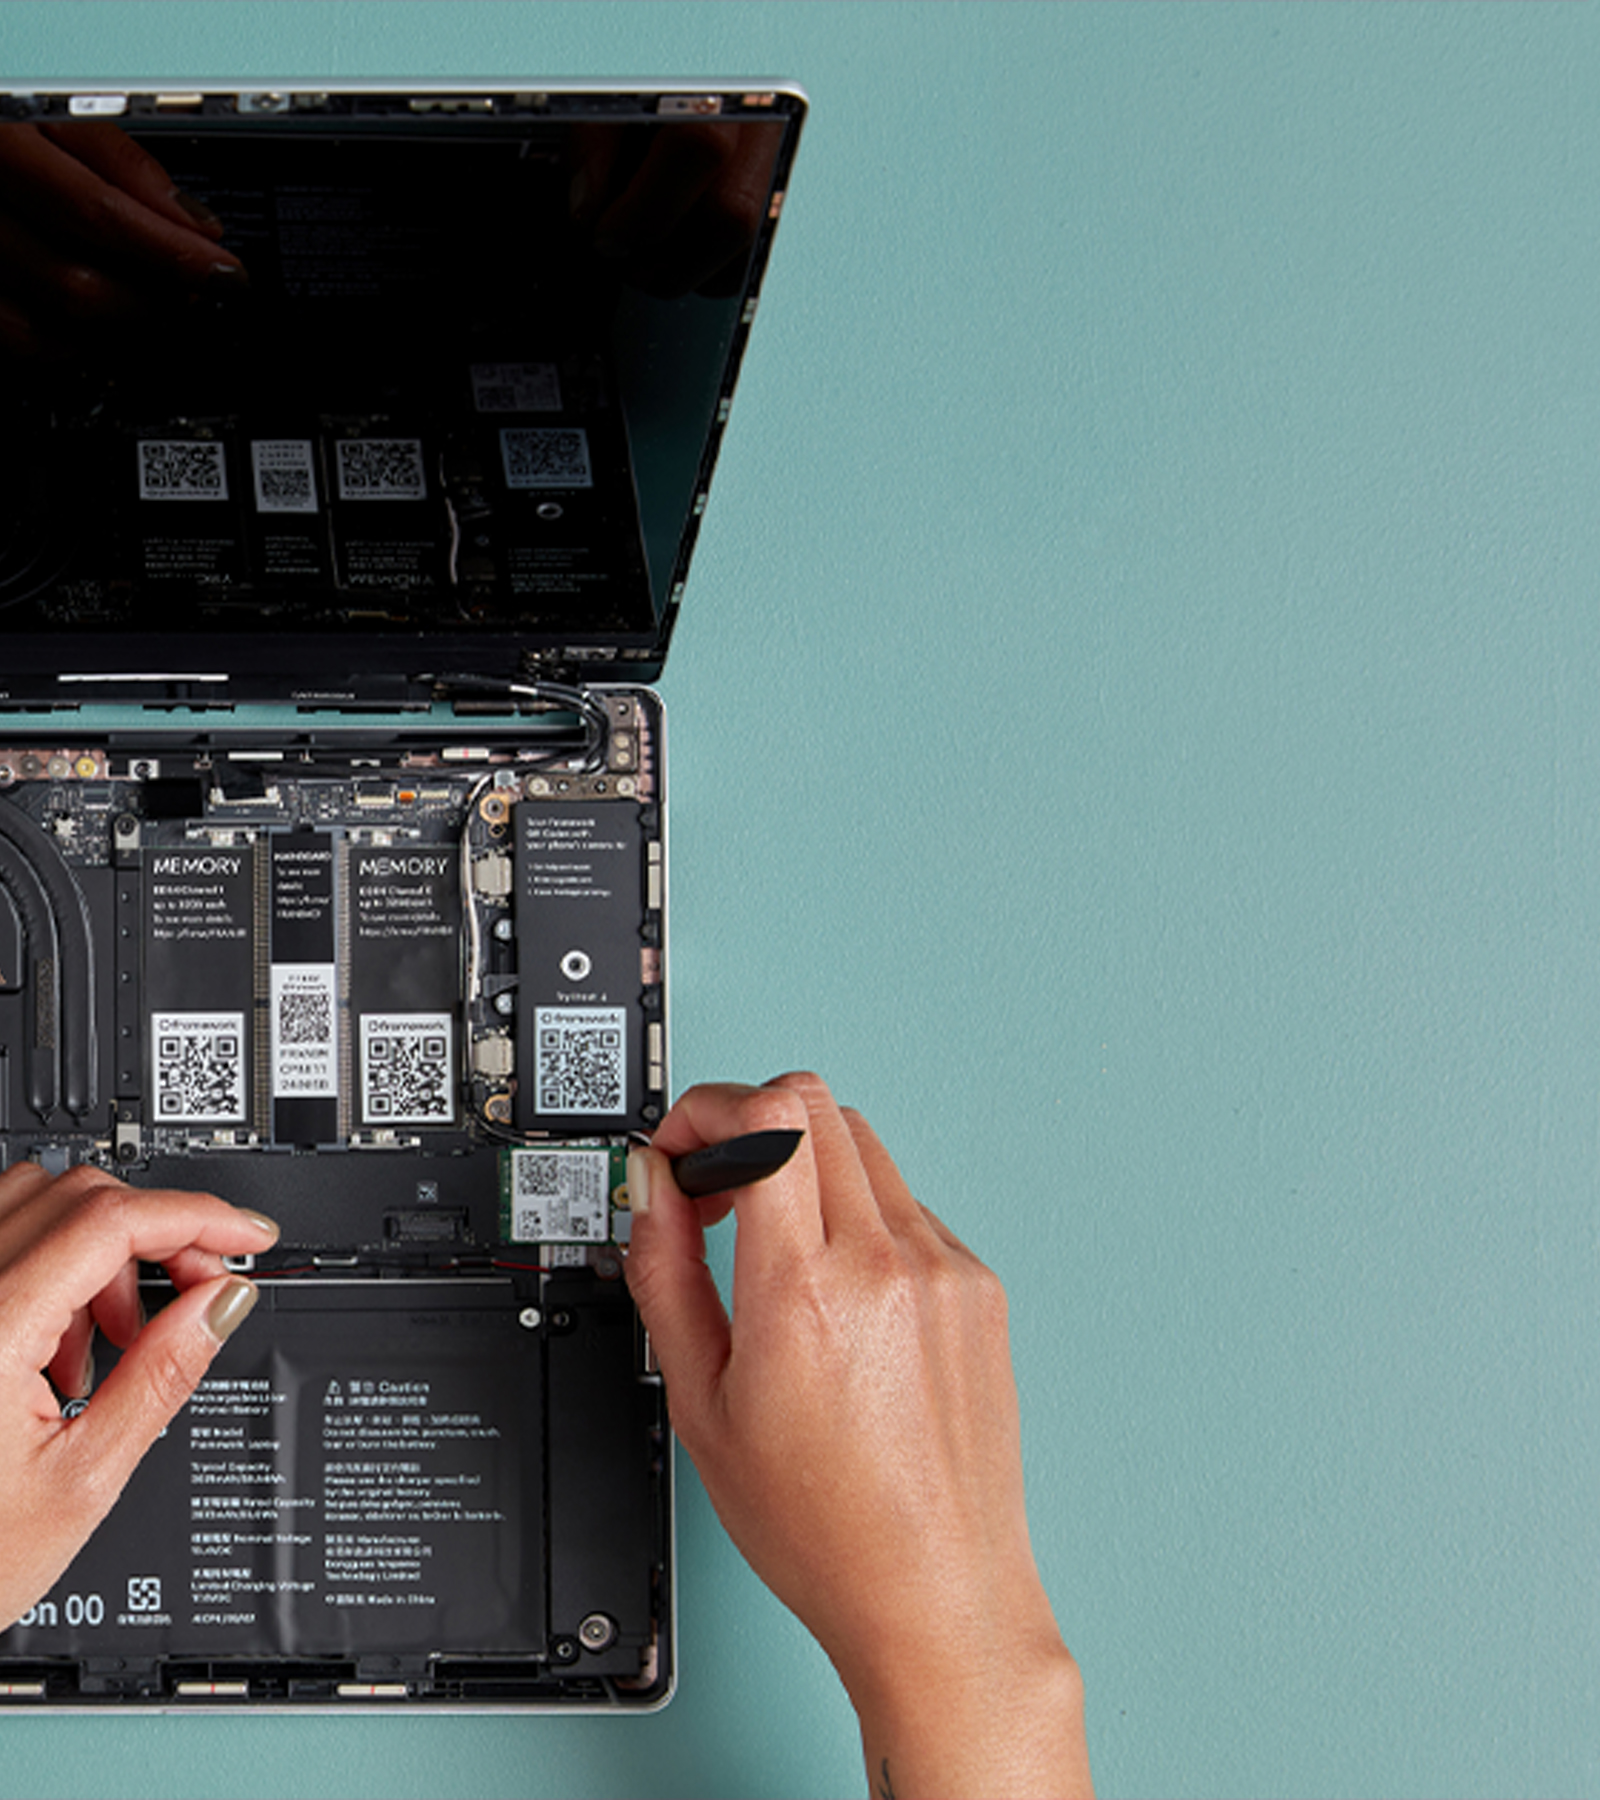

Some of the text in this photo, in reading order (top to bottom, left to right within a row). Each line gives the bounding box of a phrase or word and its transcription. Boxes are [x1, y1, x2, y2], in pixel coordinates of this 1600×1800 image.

[153, 857, 241, 875] MEMORY
[359, 857, 448, 875] MEMORY
[169, 1019, 238, 1031] framework
[377, 1020, 446, 1032] framework
[378, 1381, 430, 1393] Caution
[408, 1595, 436, 1604] China
[65, 1594, 104, 1626] 00
